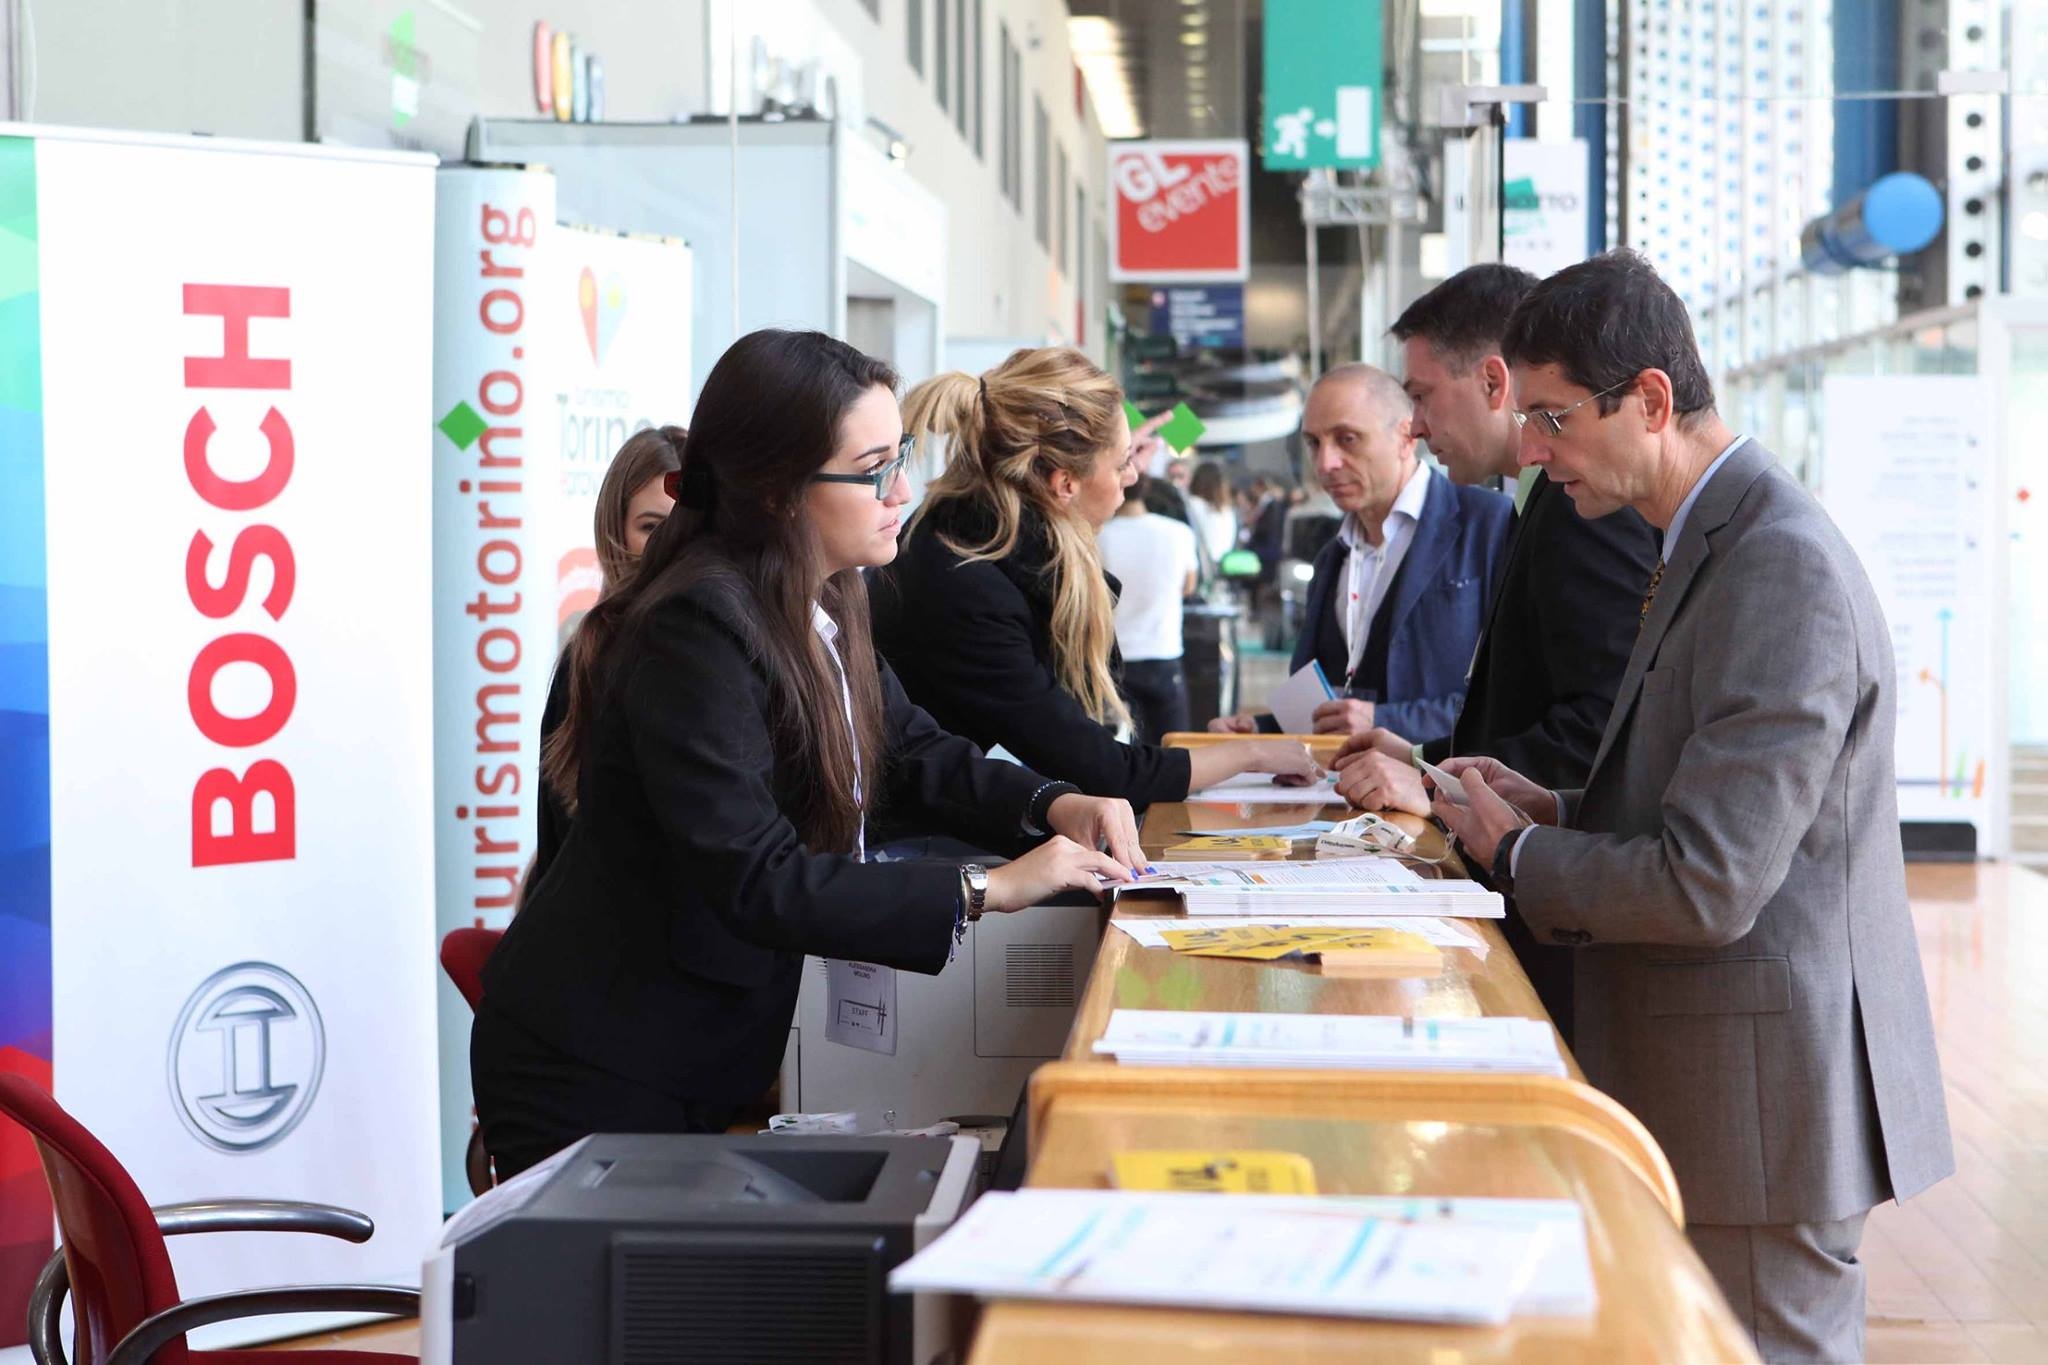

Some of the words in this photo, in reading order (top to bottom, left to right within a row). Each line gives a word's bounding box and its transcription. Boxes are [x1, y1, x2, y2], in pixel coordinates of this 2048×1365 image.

[1115, 153, 1190, 203] GL
[1136, 155, 1239, 233] events
[182, 283, 297, 867] BOSCH
[457, 203, 536, 930] urismotorino.org
